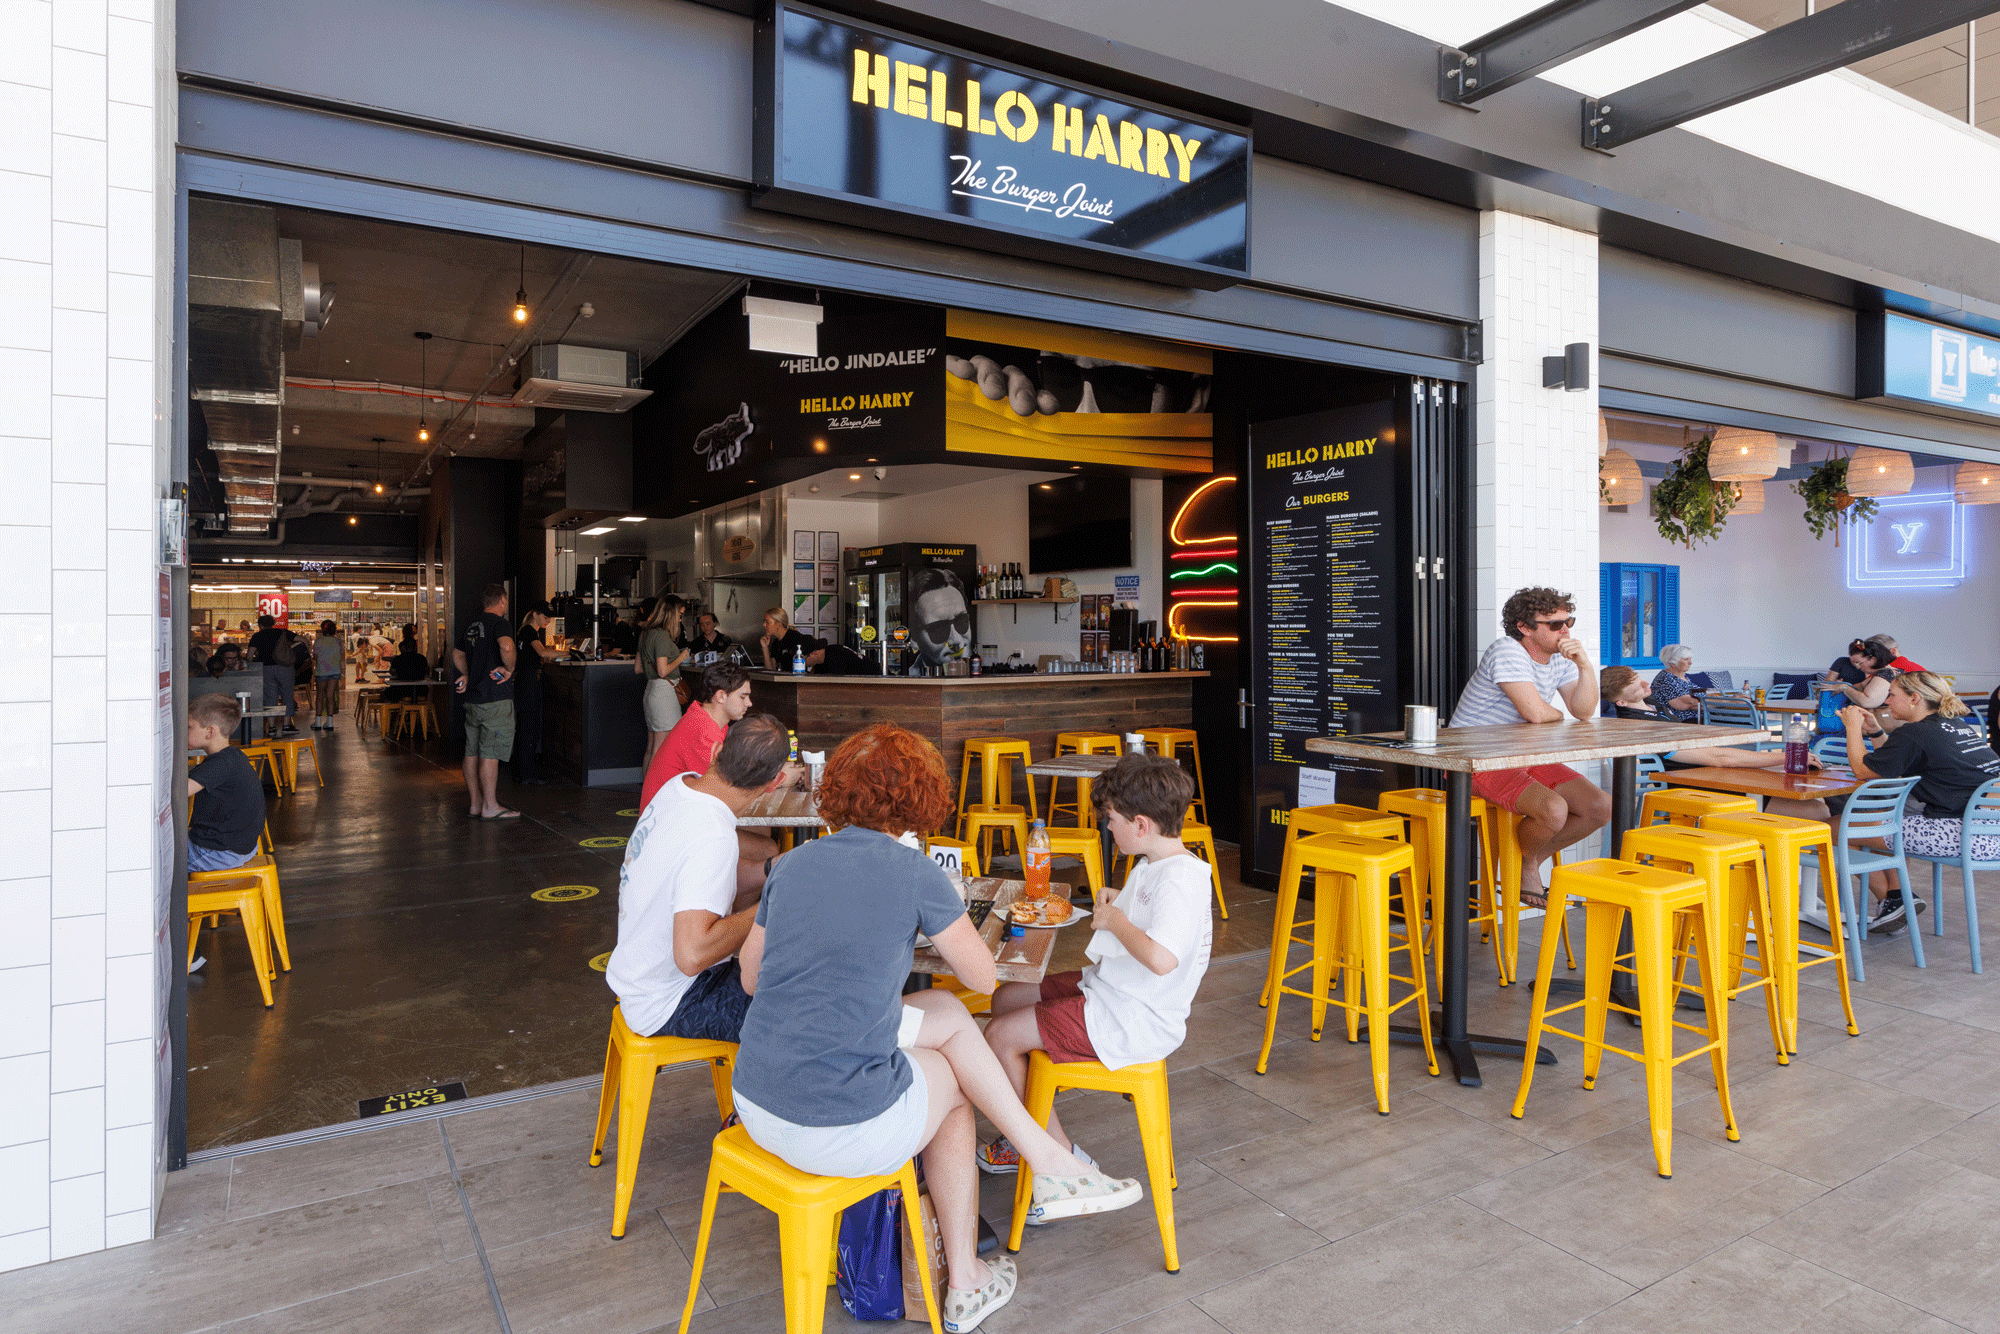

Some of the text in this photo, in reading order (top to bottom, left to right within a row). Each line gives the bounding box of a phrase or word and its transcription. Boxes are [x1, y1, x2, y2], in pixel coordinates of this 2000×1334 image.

[852, 49, 1202, 183] HELLO HARRY
[949, 155, 1114, 218] The Burger Joint
[800, 391, 914, 414] HELLO HARRY
[827, 415, 882, 429] The Burger Joint
[1266, 437, 1378, 470] HELLO HARRY
[1291, 466, 1345, 483] The Burger Joint
[1285, 491, 1350, 508] Our BURGERS
[944, 548, 965, 556] HARRY
[1115, 577, 1139, 586] NOTICE
[1313, 775, 1331, 783] Wanted
[380, 1093, 447, 1114] EXIT
[385, 1088, 438, 1103] ONLY
